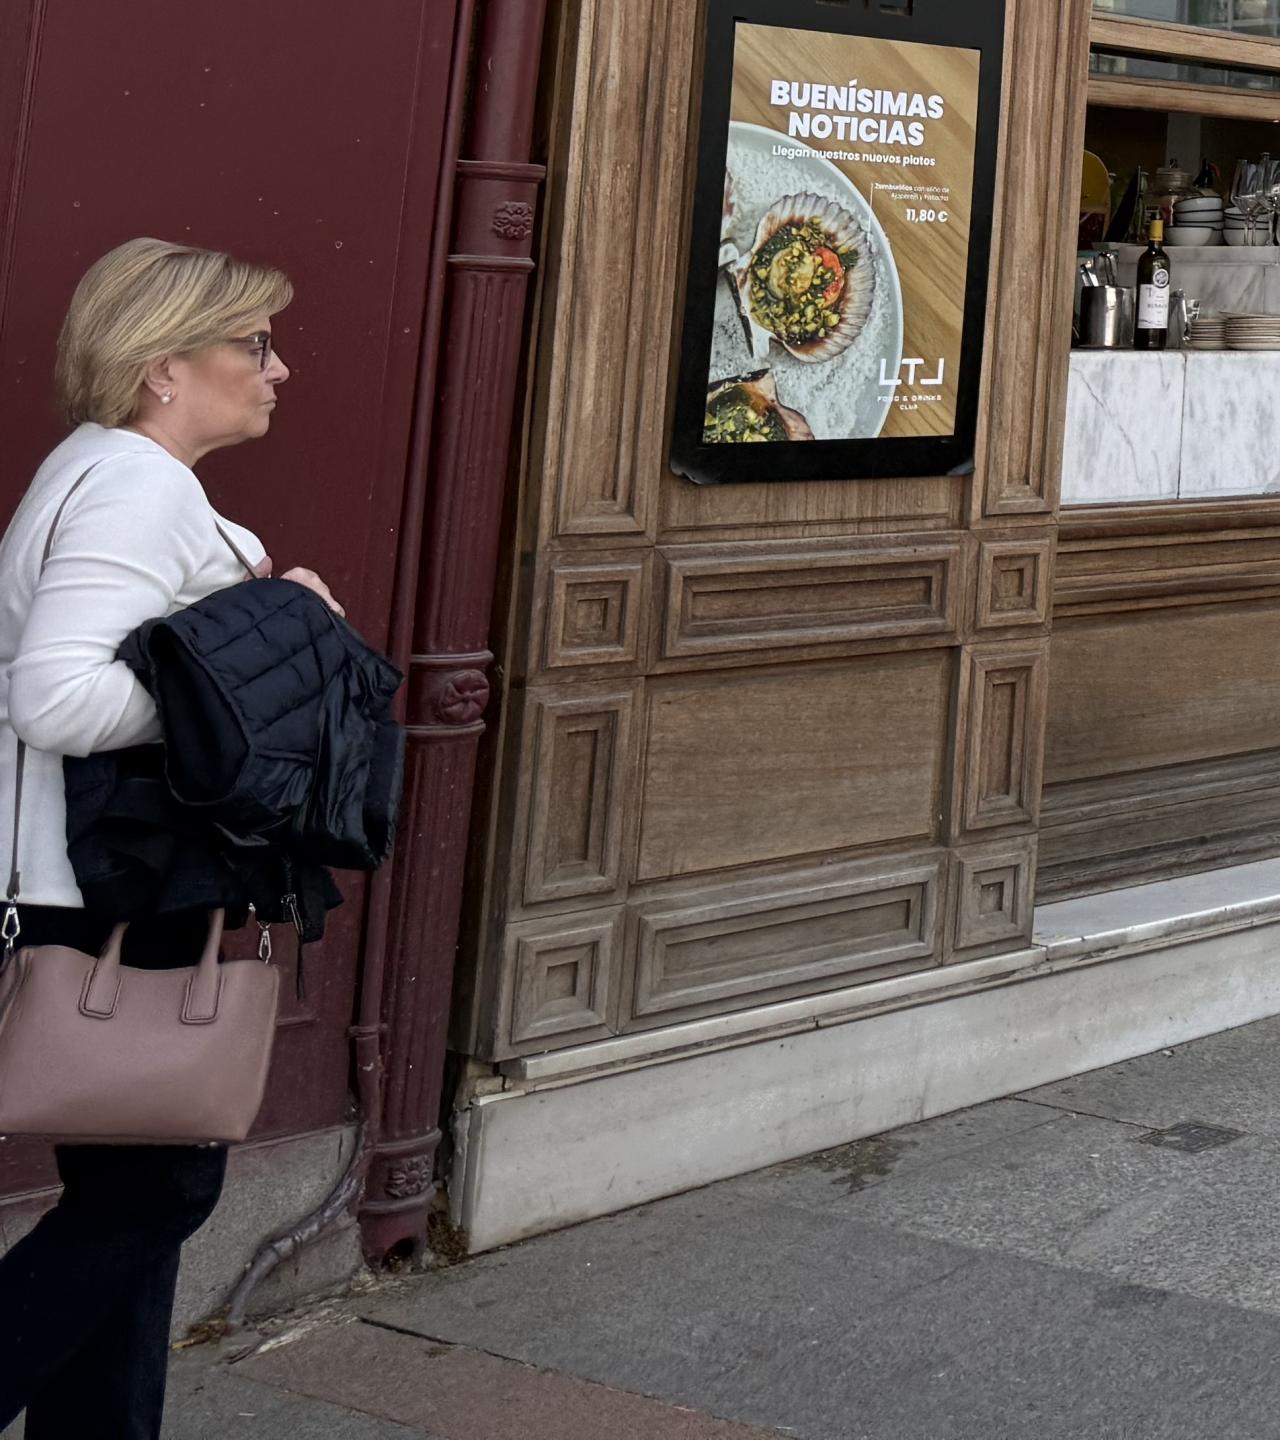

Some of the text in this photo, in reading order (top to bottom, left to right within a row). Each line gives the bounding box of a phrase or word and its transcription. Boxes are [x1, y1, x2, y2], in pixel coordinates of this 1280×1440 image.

[769, 79, 944, 120] BUENÍSIMAS
[788, 112, 925, 146] NOTICIAS
[772, 145, 936, 167] Llegan nuestros nuevos platos
[906, 208, 948, 223] 11,80 €
